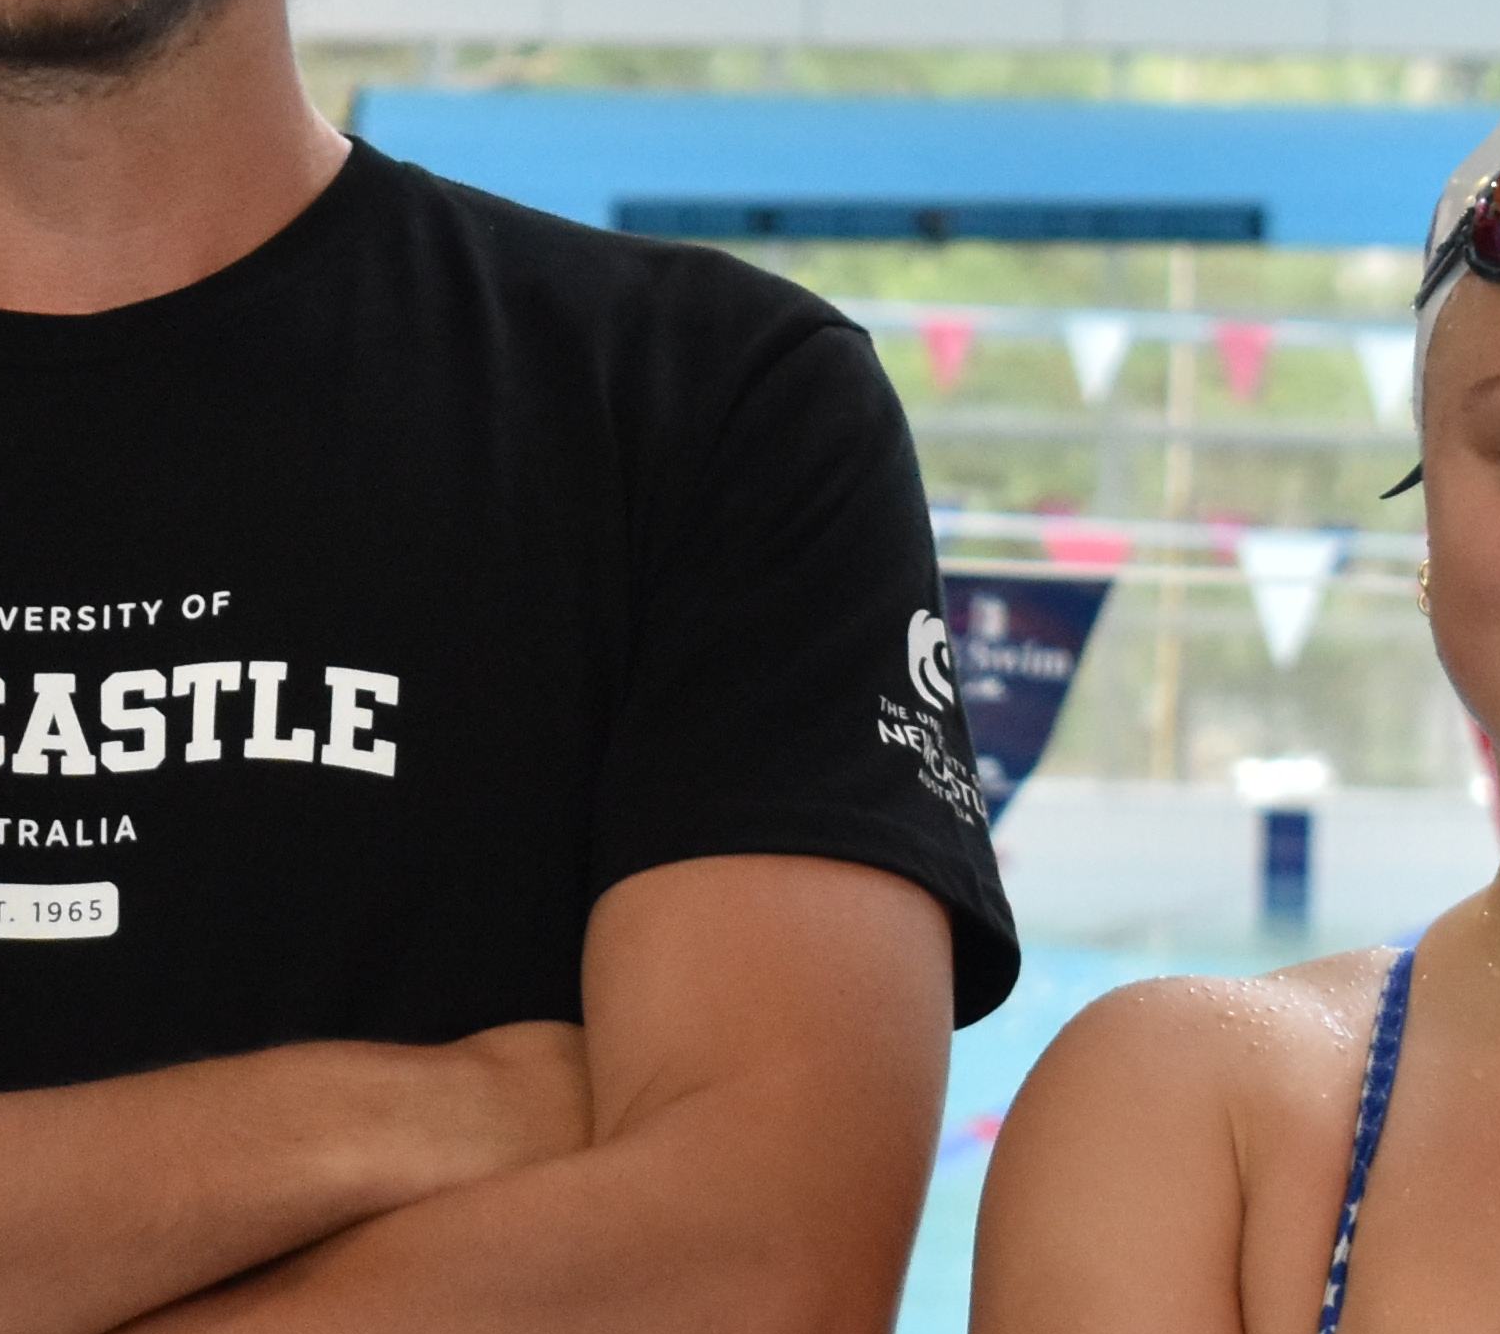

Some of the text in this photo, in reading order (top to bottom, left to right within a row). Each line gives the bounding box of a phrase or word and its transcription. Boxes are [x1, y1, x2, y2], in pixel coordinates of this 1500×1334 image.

[181, 590, 232, 620] OF
[879, 694, 909, 721] THE
[32, 899, 103, 923] 1965
